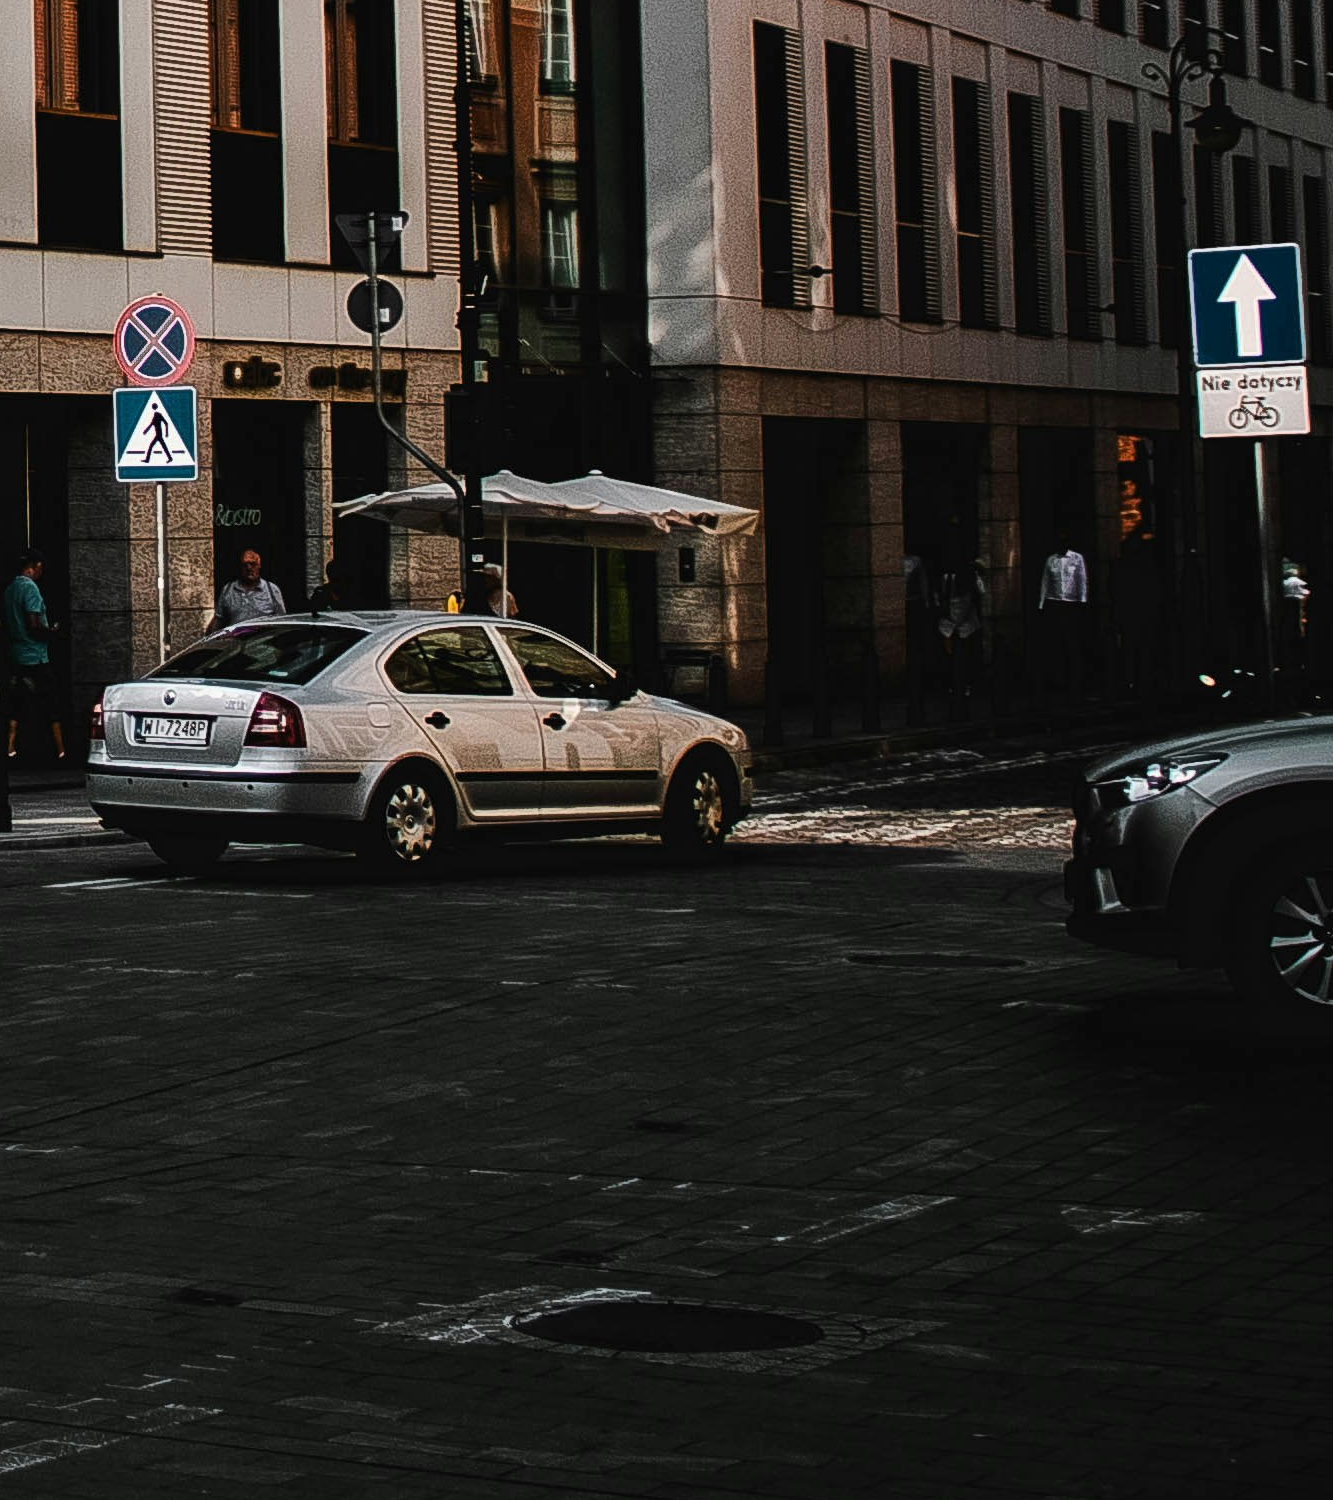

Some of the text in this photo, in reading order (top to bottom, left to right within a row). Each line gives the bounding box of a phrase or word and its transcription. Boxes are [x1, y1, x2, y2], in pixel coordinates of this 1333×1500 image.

[1201, 374, 1303, 392] Nie dotyczy
[144, 719, 206, 737] WI 7248P
